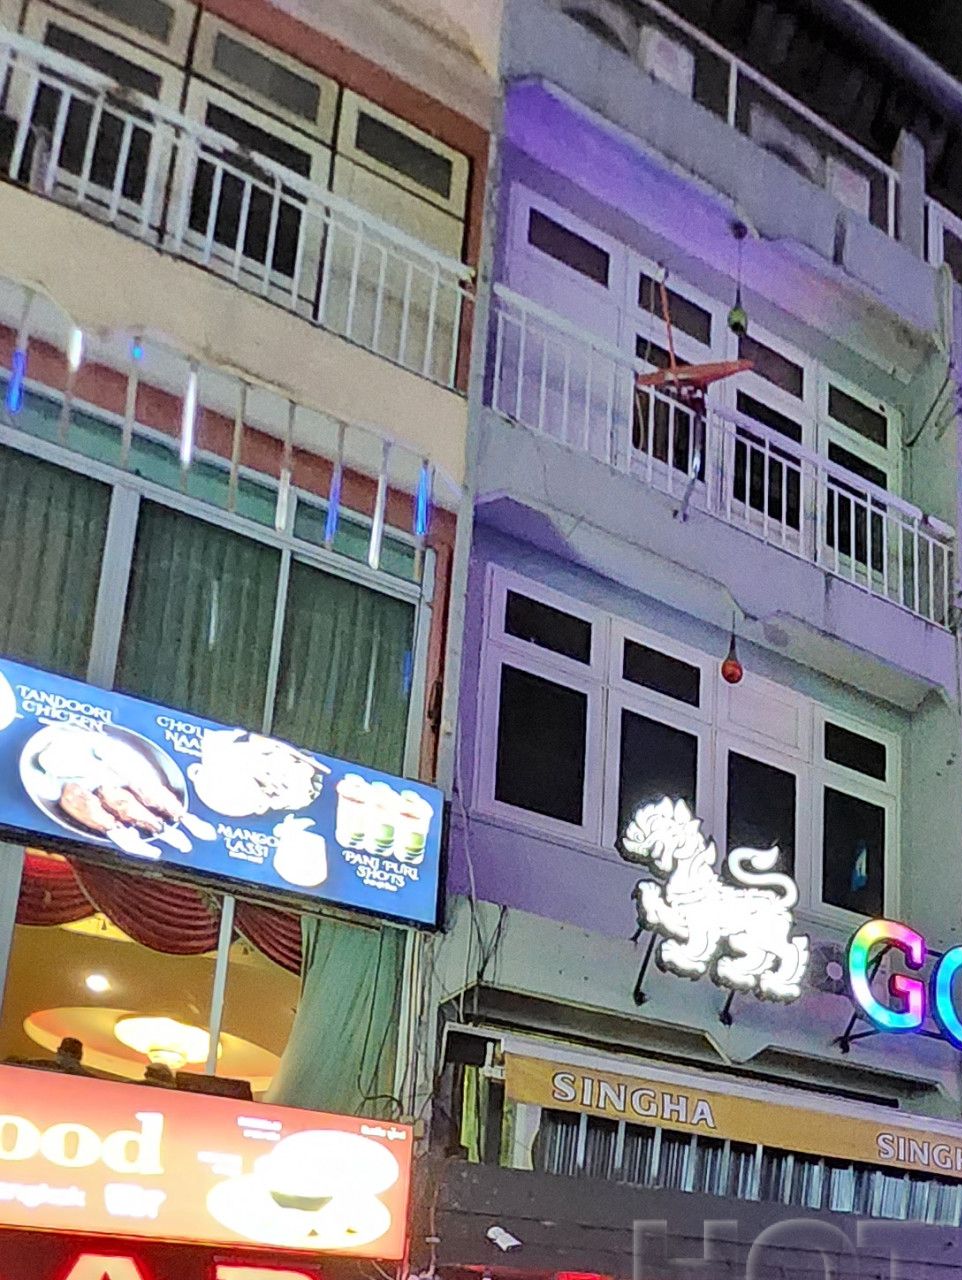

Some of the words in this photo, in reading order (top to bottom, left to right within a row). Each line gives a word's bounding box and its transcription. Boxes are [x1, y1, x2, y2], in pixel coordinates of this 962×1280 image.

[16, 684, 113, 724] TANDOORI
[22, 700, 107, 735] CHICKEN
[217, 823, 279, 848] MANGO
[224, 837, 269, 857] LASSI
[341, 850, 380, 871] PANI
[382, 860, 420, 881] PURI
[356, 865, 405, 888] SHOTS
[552, 1071, 717, 1129] SINGHA
